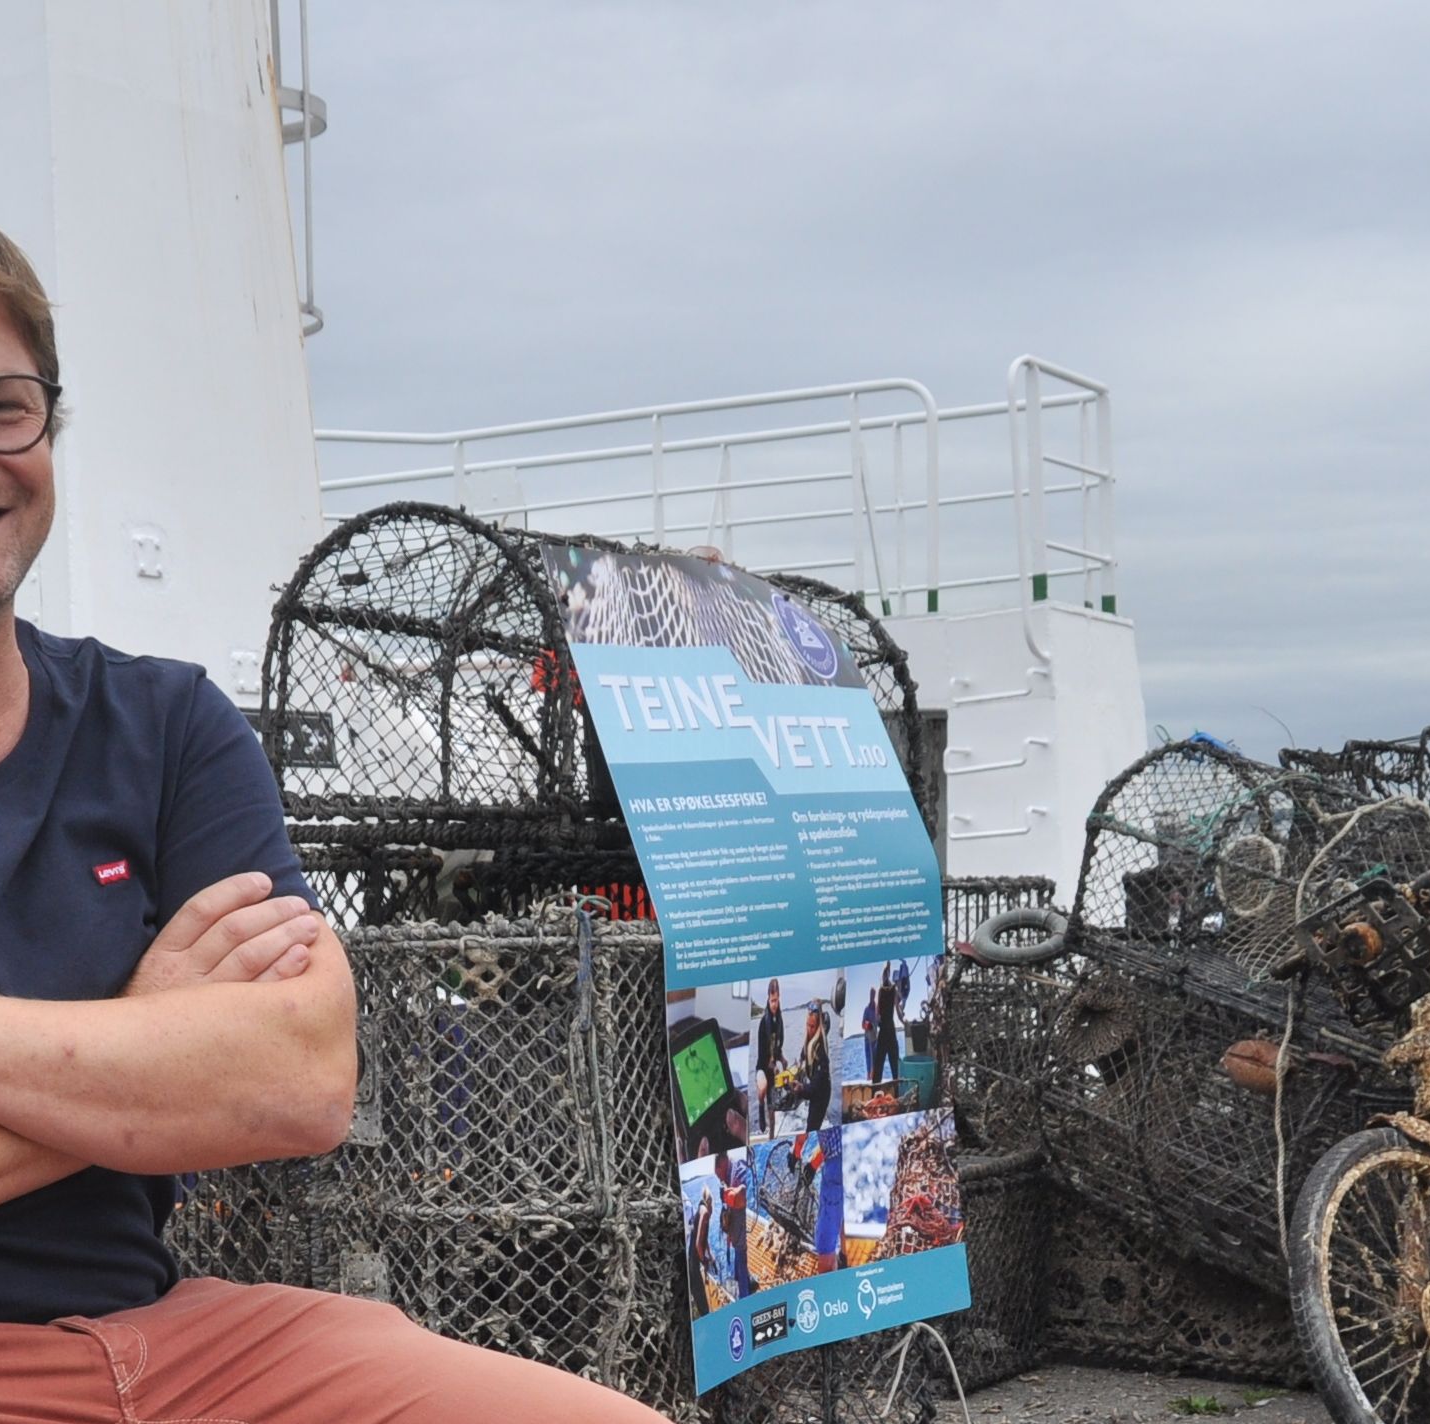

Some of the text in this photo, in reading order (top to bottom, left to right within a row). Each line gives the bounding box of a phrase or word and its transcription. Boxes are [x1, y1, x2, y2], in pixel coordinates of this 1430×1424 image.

[598, 674, 752, 731] TEINE
[628, 798, 656, 814] HVA
[656, 797, 673, 812] ER
[823, 1299, 849, 1318] Oslo
